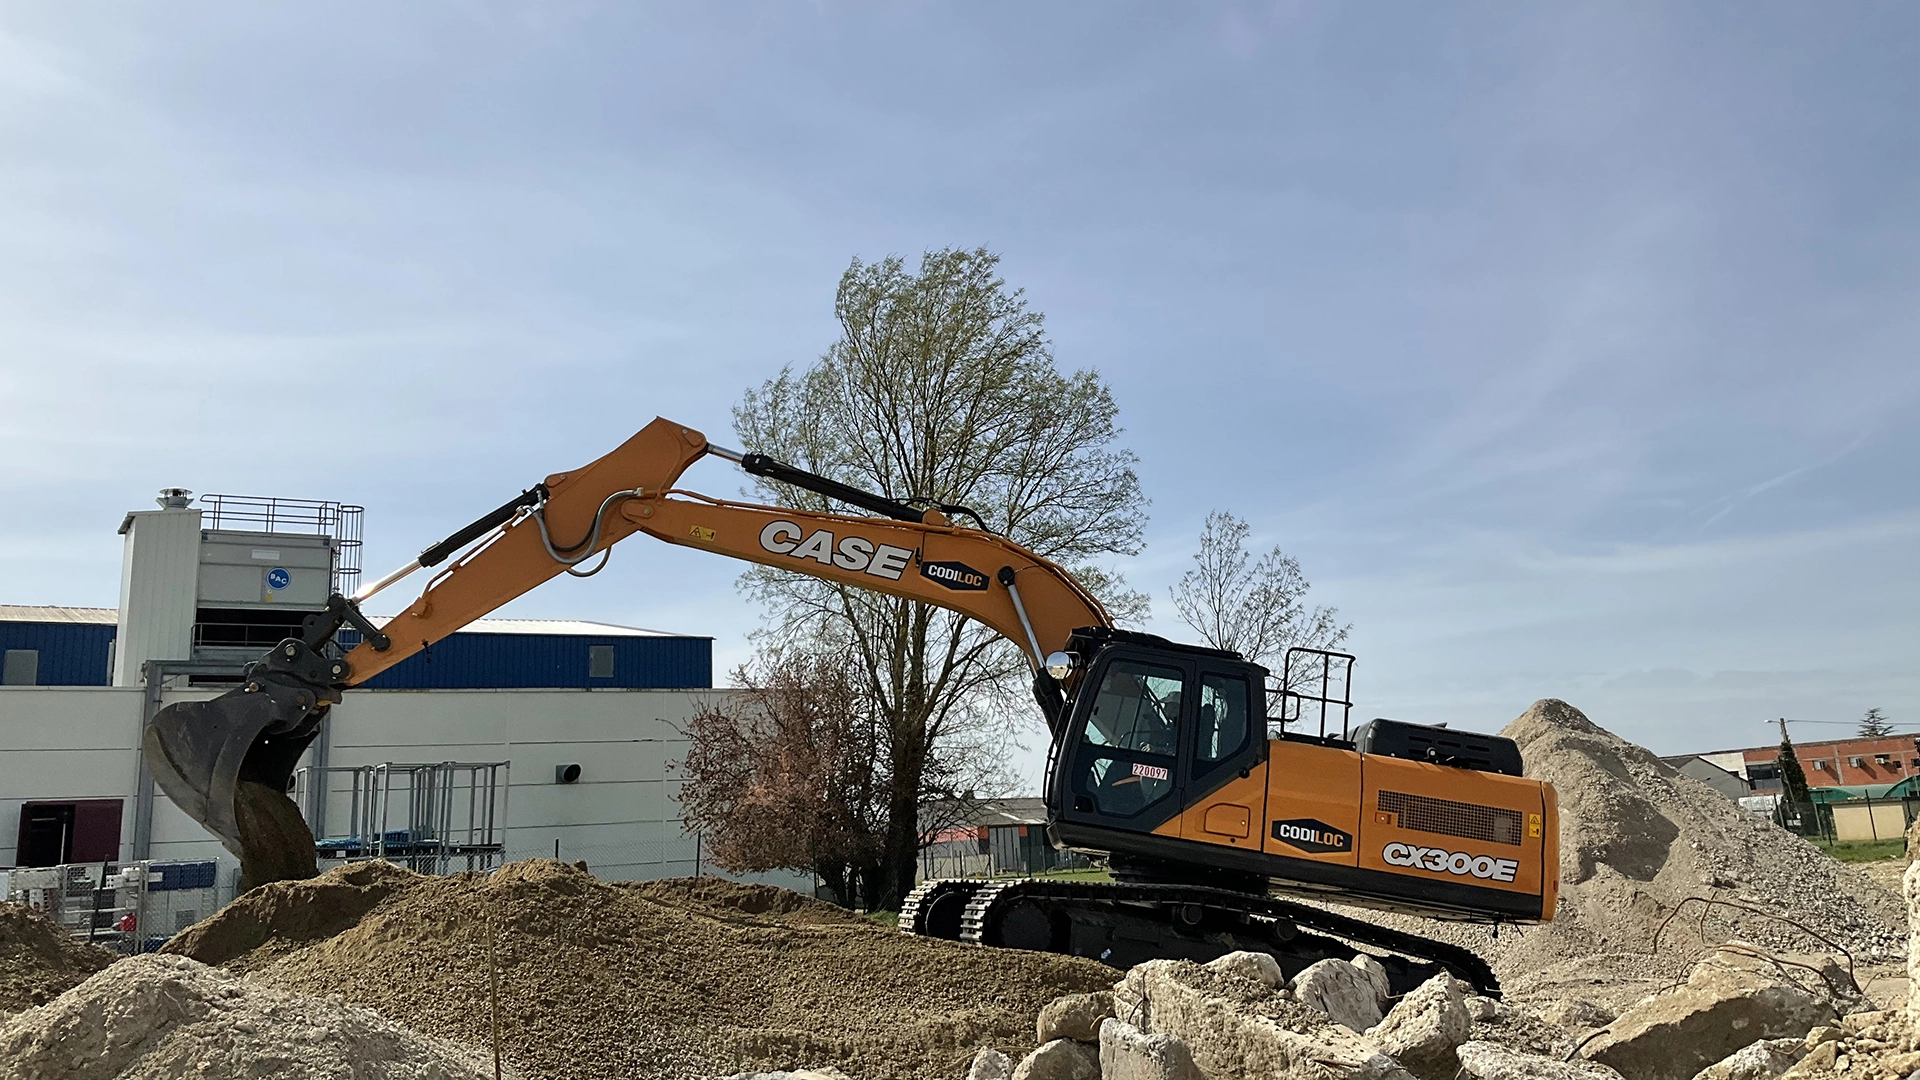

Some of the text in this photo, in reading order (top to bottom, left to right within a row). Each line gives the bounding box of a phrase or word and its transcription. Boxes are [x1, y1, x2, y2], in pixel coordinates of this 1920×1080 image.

[759, 520, 915, 581] CASE
[270, 573, 287, 585] BAC
[928, 564, 983, 587] CODILOC
[1133, 764, 1167, 779] 220097
[1279, 823, 1344, 848] CODILOC
[1382, 841, 1519, 883] CX300E
